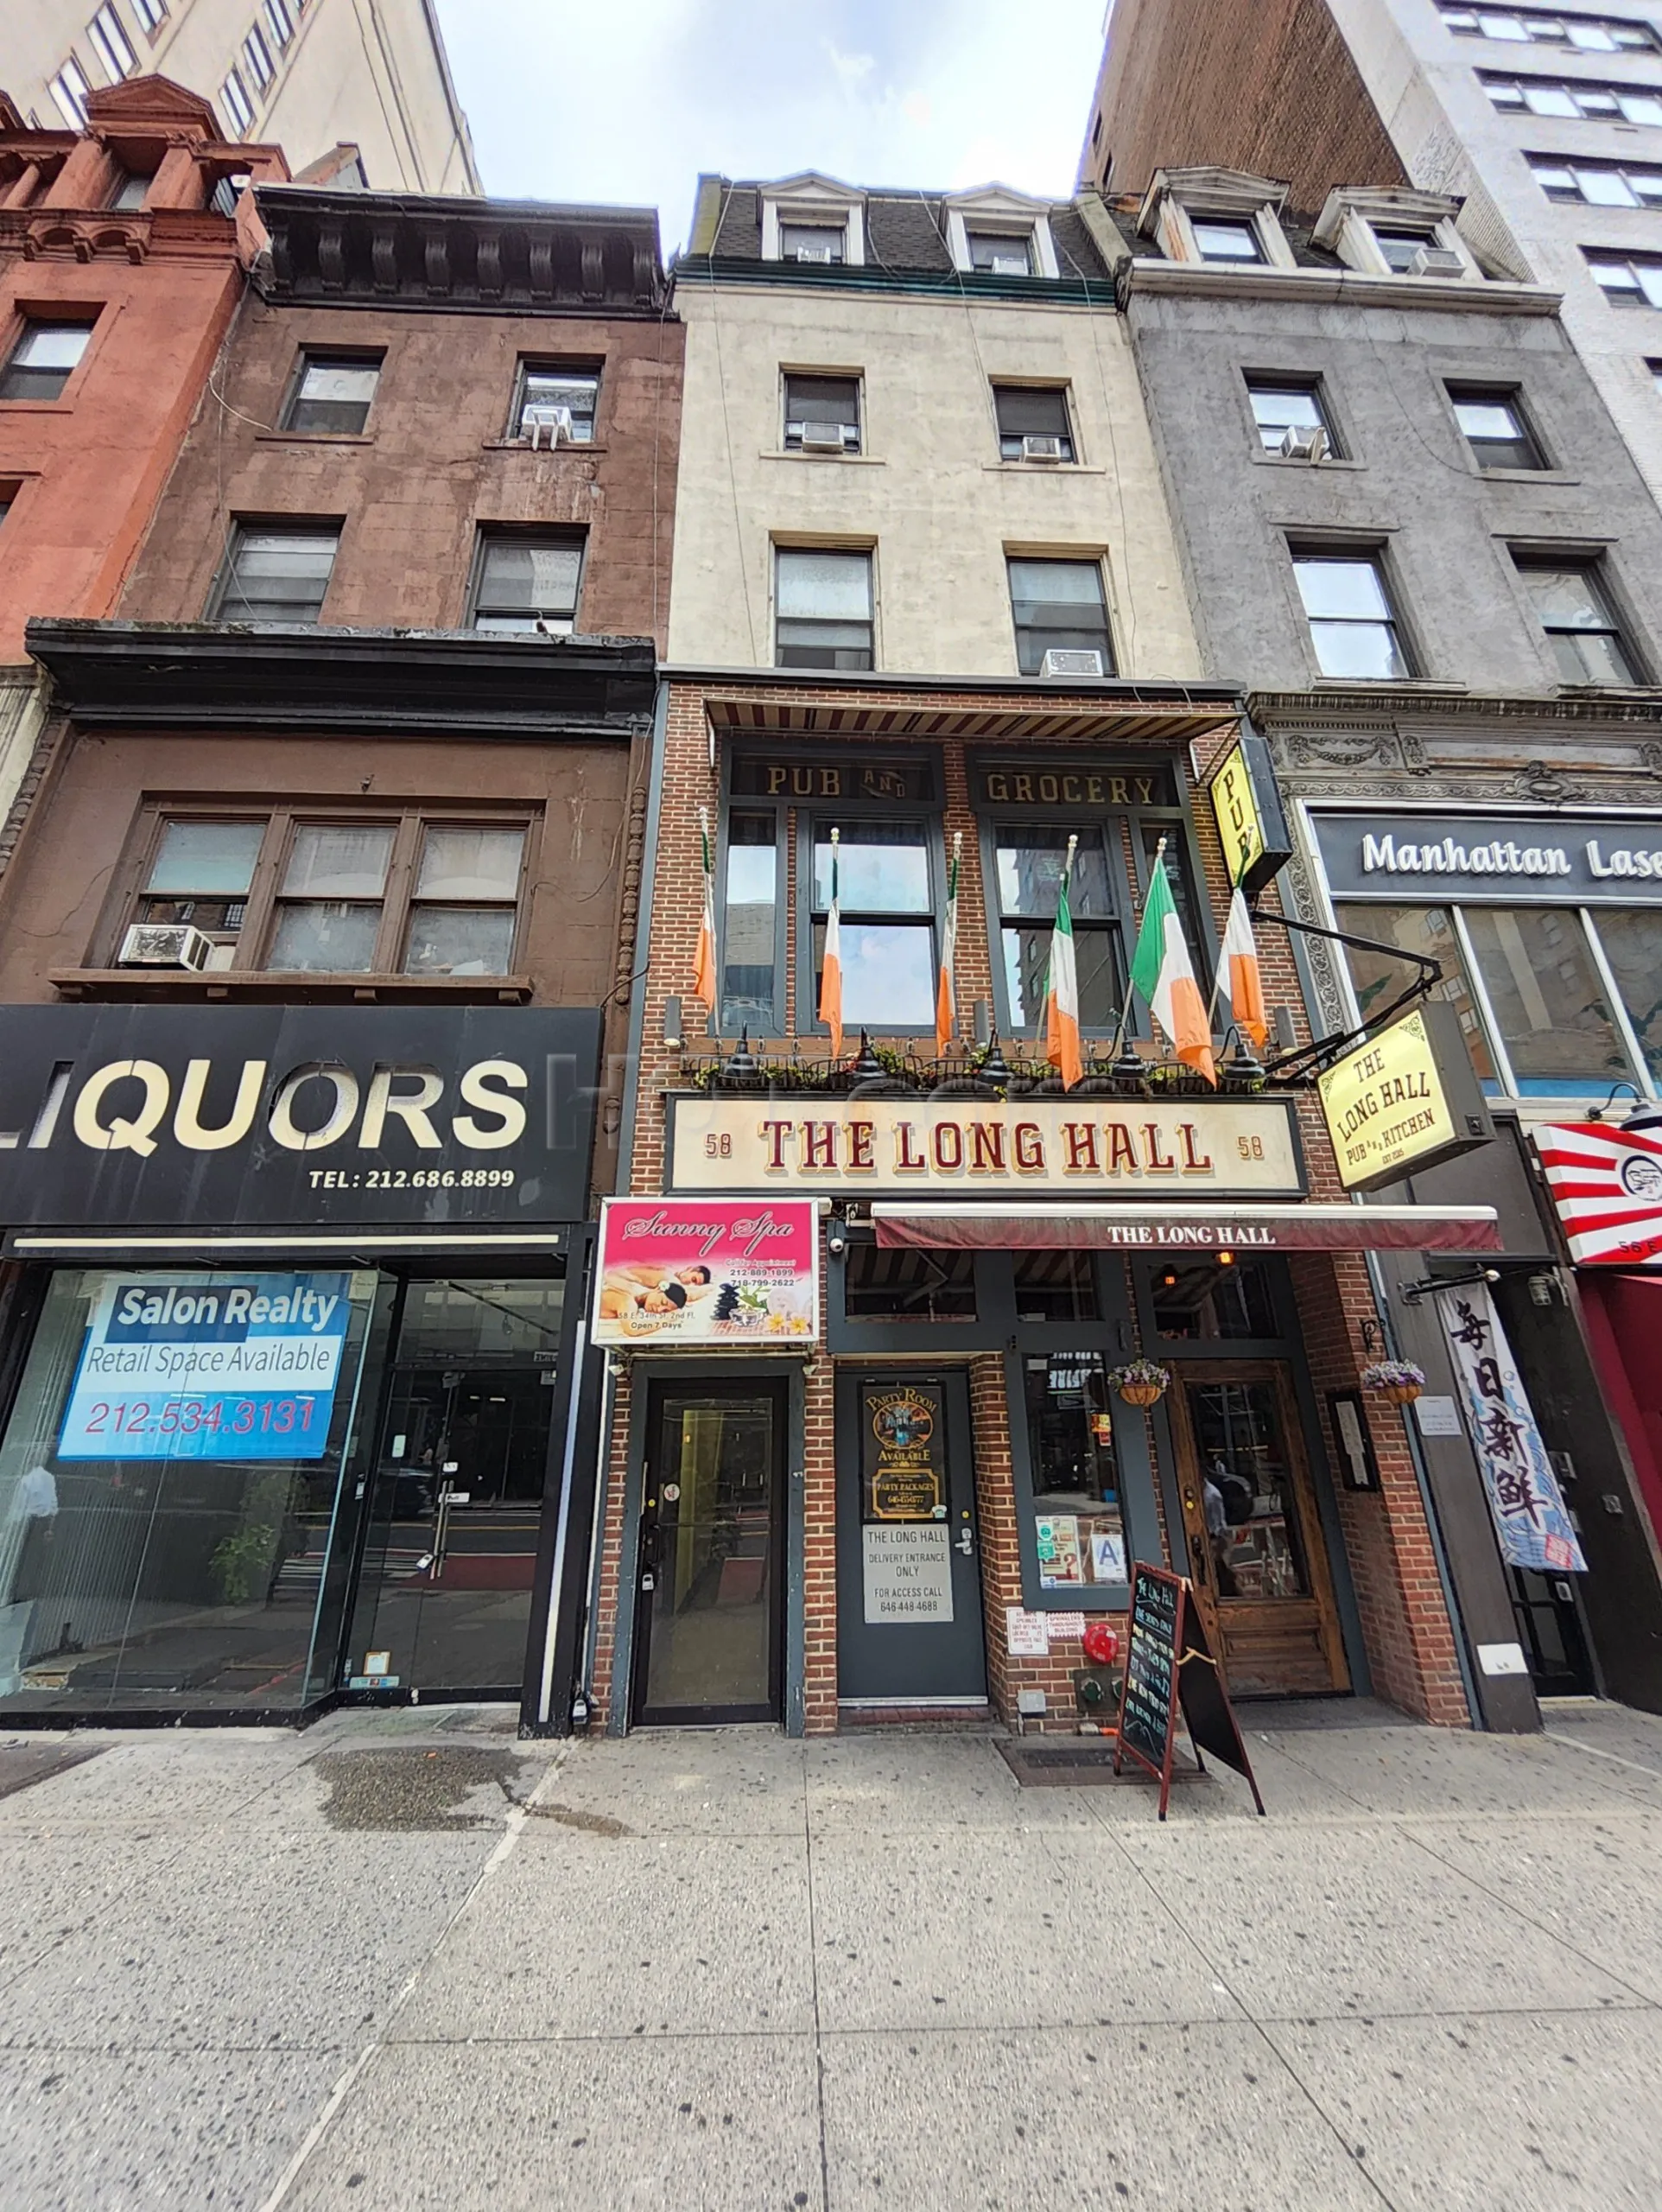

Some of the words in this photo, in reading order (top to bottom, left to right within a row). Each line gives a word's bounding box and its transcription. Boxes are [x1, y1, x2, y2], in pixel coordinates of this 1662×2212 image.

[767, 767, 841, 795] PUB
[864, 770, 905, 798] AND
[986, 773, 1153, 804] GROCERY
[1362, 834, 1571, 874] Manhattan
[1354, 1047, 1385, 1084] THE
[1337, 1092, 1379, 1143] LONG
[1379, 1071, 1430, 1109] HALL
[702, 1134, 733, 1159] 58
[758, 1120, 878, 1177] THE
[892, 1121, 1048, 1178] LONG
[1062, 1122, 1216, 1179] HALL
[1235, 1135, 1264, 1160] 58
[1347, 1143, 1367, 1166] PUB
[1382, 1108, 1436, 1148] KITCHEN
[365, 1170, 514, 1189] 212.686.8899
[622, 1211, 726, 1256] Sunny
[729, 1211, 794, 1256] Spa
[1107, 1226, 1153, 1243] THE
[1158, 1226, 1213, 1243] LONG
[1215, 1226, 1276, 1244] HALL
[117, 1287, 219, 1325] Salon
[224, 1287, 339, 1332] Realty
[87, 1344, 153, 1372] Retail
[155, 1345, 224, 1379] Space
[227, 1343, 330, 1372] Available
[85, 1400, 315, 1434] 212.534.3131
[867, 1531, 887, 1543] THE
[890, 1531, 917, 1543] LONG
[920, 1530, 946, 1542] HALL
[1099, 1540, 1119, 1566] A
[869, 1554, 904, 1563] DELIVERY
[905, 1553, 946, 1562] ENTRANCE
[896, 1566, 920, 1577] ONLY
[874, 1588, 890, 1598] FOR
[891, 1588, 922, 1598] ACCESS
[923, 1587, 942, 1597] CALL
